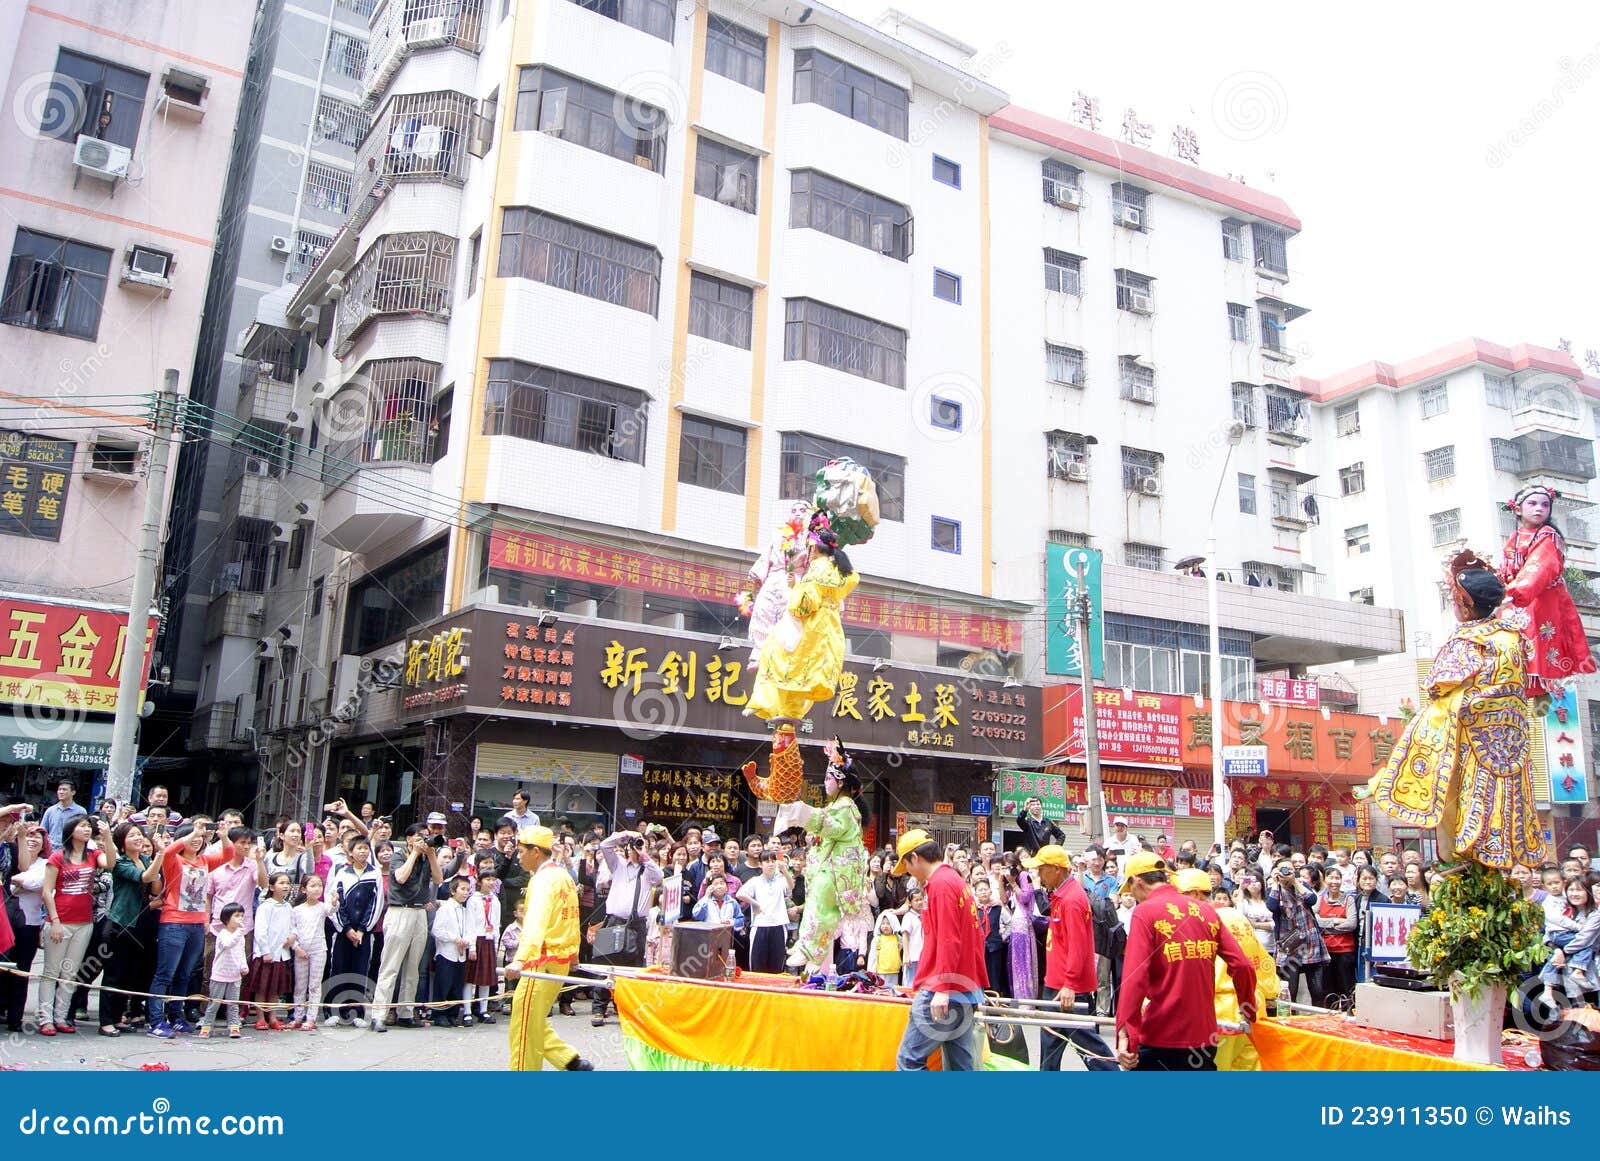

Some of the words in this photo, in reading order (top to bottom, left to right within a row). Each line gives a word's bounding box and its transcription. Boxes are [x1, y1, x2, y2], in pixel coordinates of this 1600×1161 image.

[2, 466, 28, 515] 毛笔
[36, 472, 65, 520] 硬笔
[504, 643, 575, 666] 特色客家菜
[1093, 690, 1162, 710] 招商
[1263, 679, 1288, 698] 租房
[1292, 681, 1318, 700] 住宿
[832, 671, 961, 730] 農家土菜
[971, 708, 1027, 726] 27699722
[907, 729, 955, 748] 鸣乐分店
[971, 724, 1027, 742] 27699733
